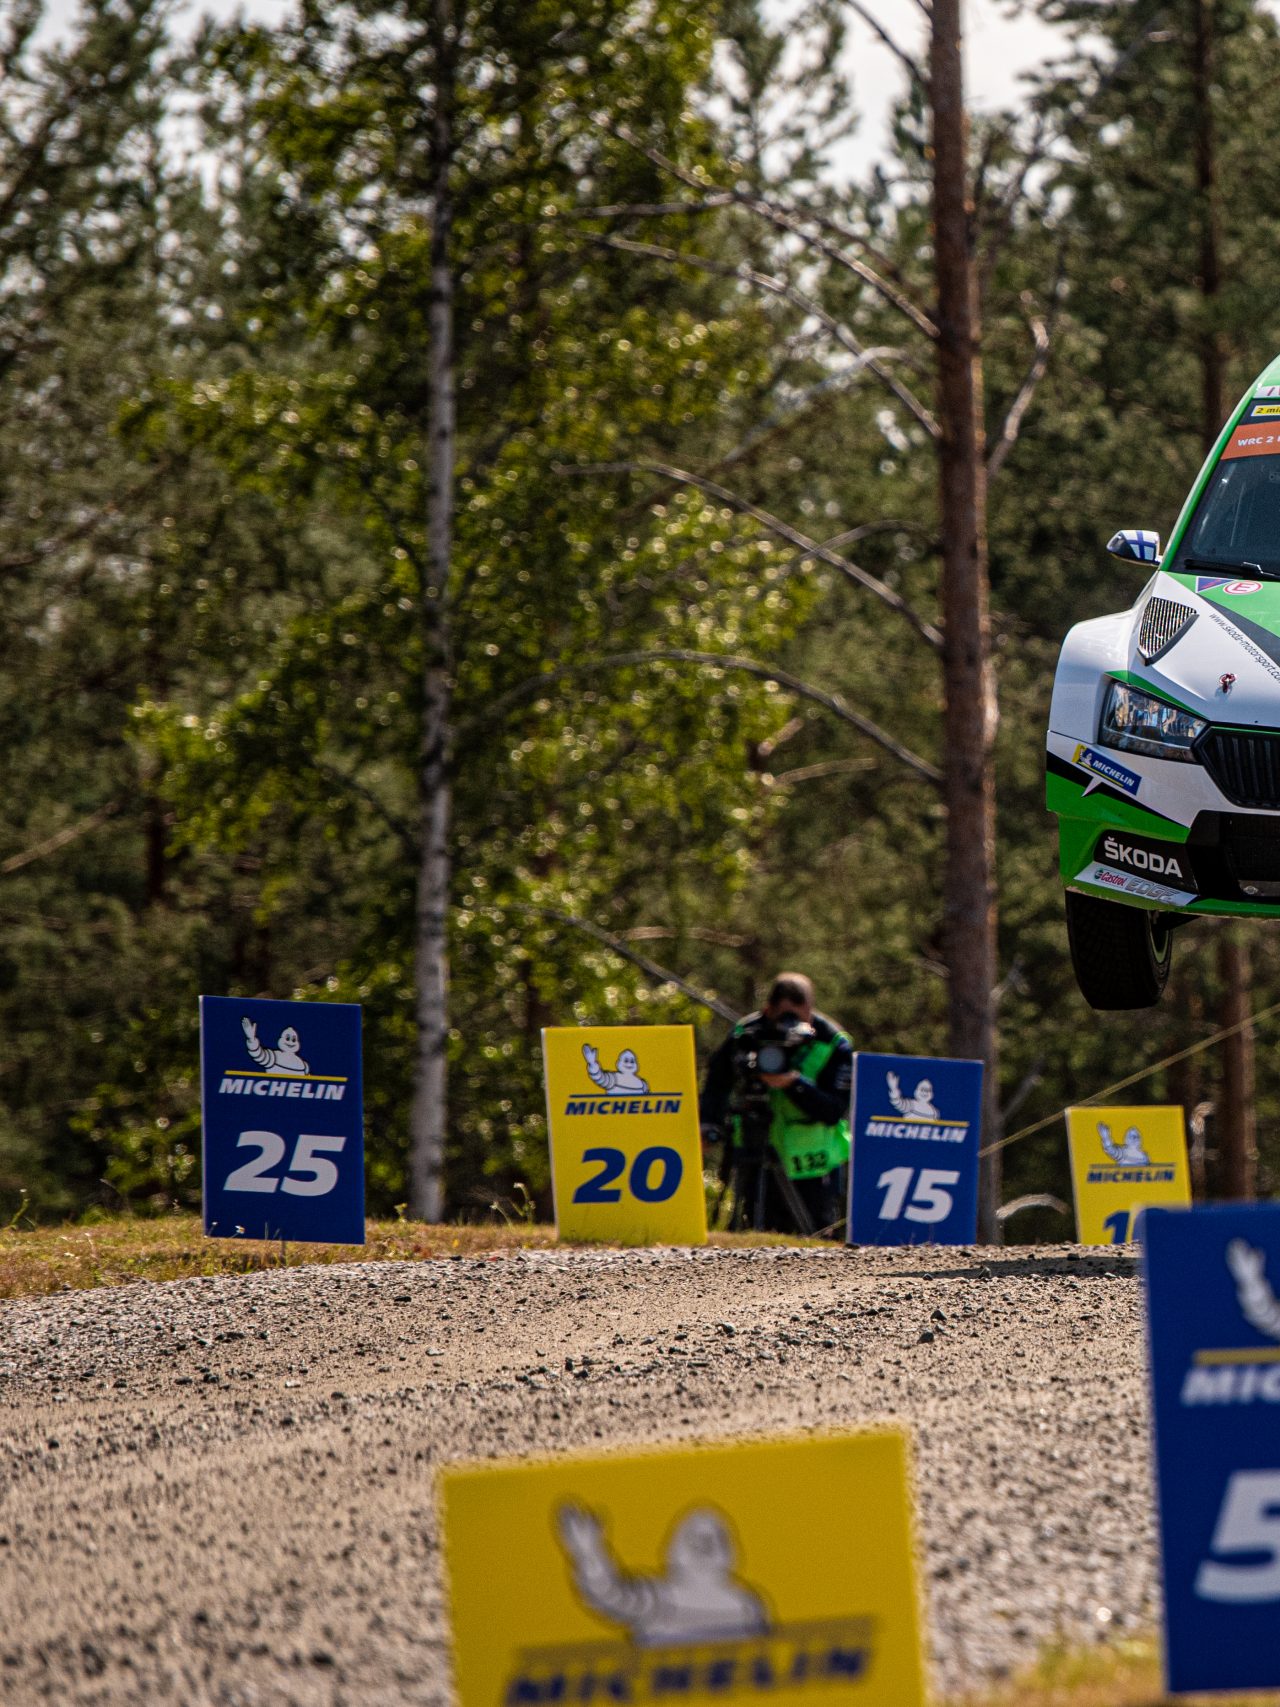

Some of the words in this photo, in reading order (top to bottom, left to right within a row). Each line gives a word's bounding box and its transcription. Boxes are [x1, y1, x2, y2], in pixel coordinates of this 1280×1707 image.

[1237, 437, 1263, 447] WRC
[1265, 435, 1273, 444] 2
[1092, 759, 1135, 788] MICHELIN
[1103, 835, 1184, 879] ŠKODA
[1100, 871, 1128, 888] Castrol
[218, 1077, 347, 1101] MICHELIN
[563, 1099, 683, 1117] MICHELIN
[865, 1121, 969, 1144] MICHELIN
[223, 1130, 348, 1197] 25
[572, 1146, 684, 1204] 20
[1087, 1170, 1175, 1184] MICHELIN
[876, 1166, 961, 1224] 15
